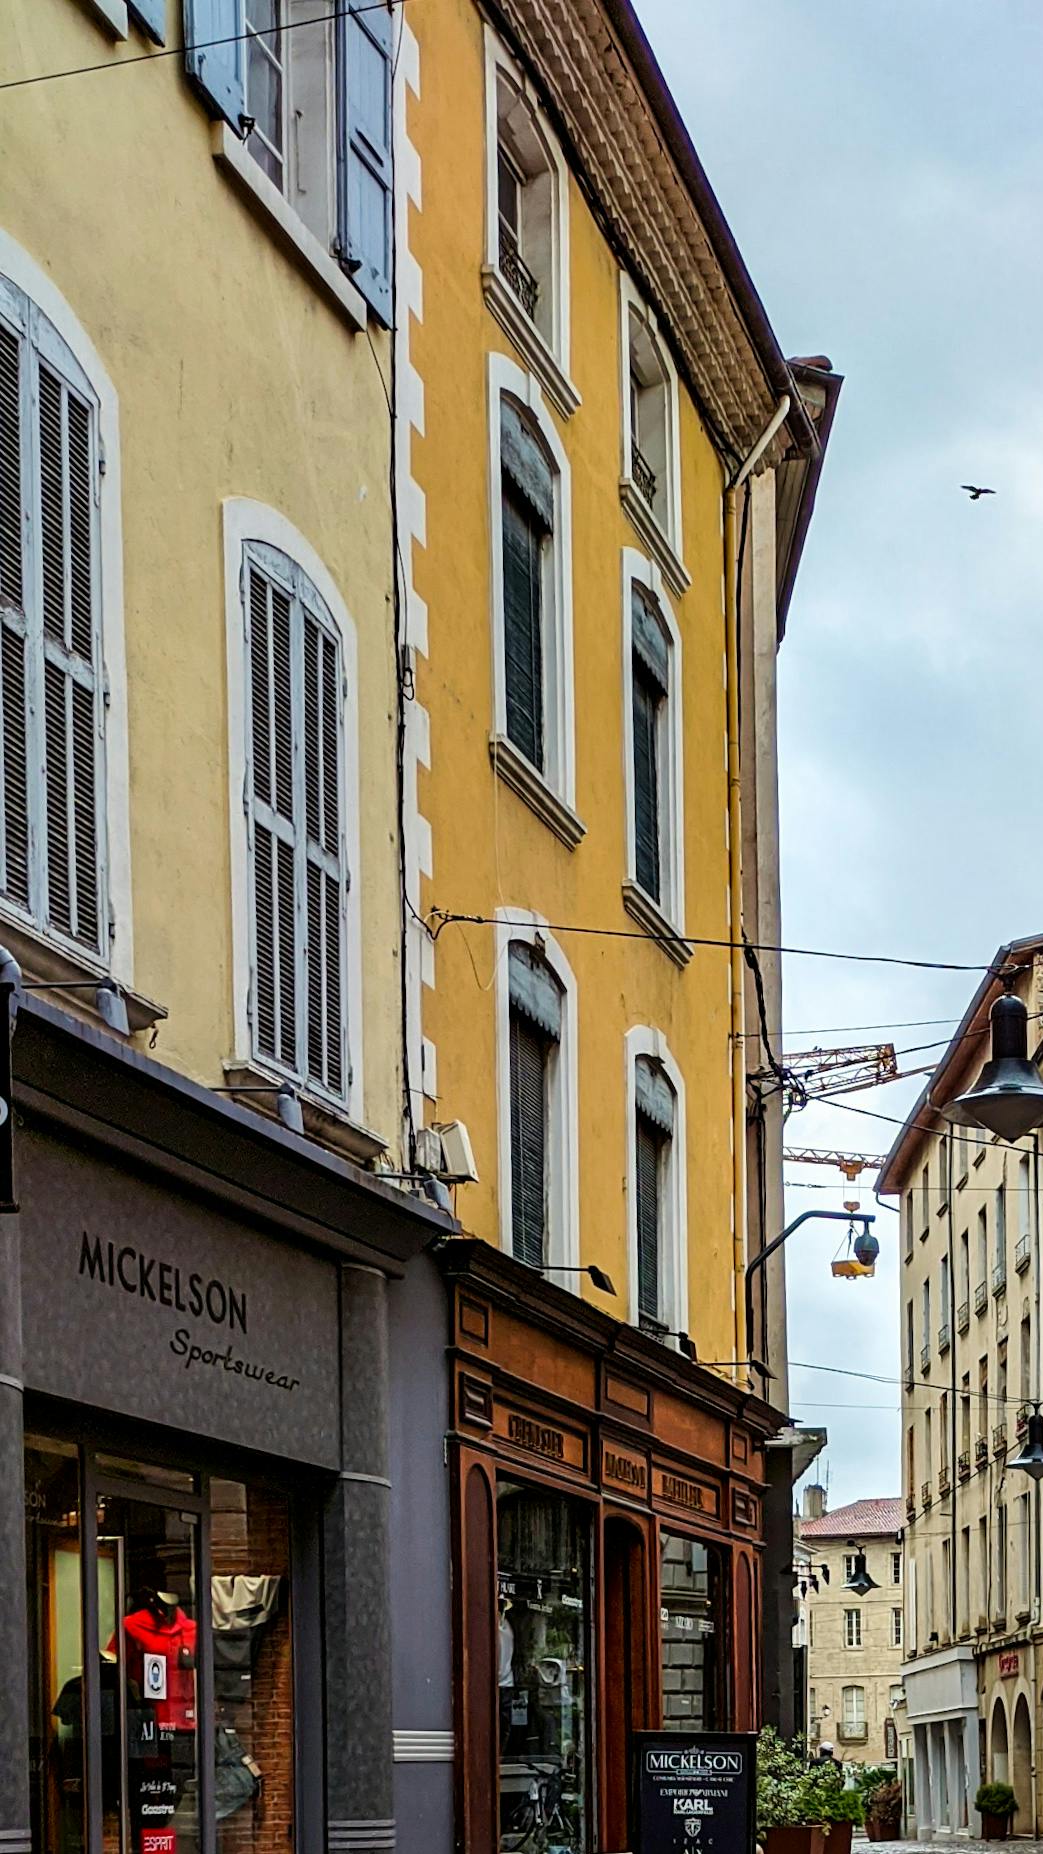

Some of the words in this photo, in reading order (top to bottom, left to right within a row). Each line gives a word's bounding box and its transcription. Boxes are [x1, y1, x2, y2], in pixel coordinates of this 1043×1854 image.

[79, 1231, 248, 1334] MICKELSON
[170, 1329, 300, 1391] Sportswear
[650, 1754, 738, 1770] MICKELSON
[674, 1798, 713, 1811] KARL
[144, 1835, 174, 1852] ESPRIT
